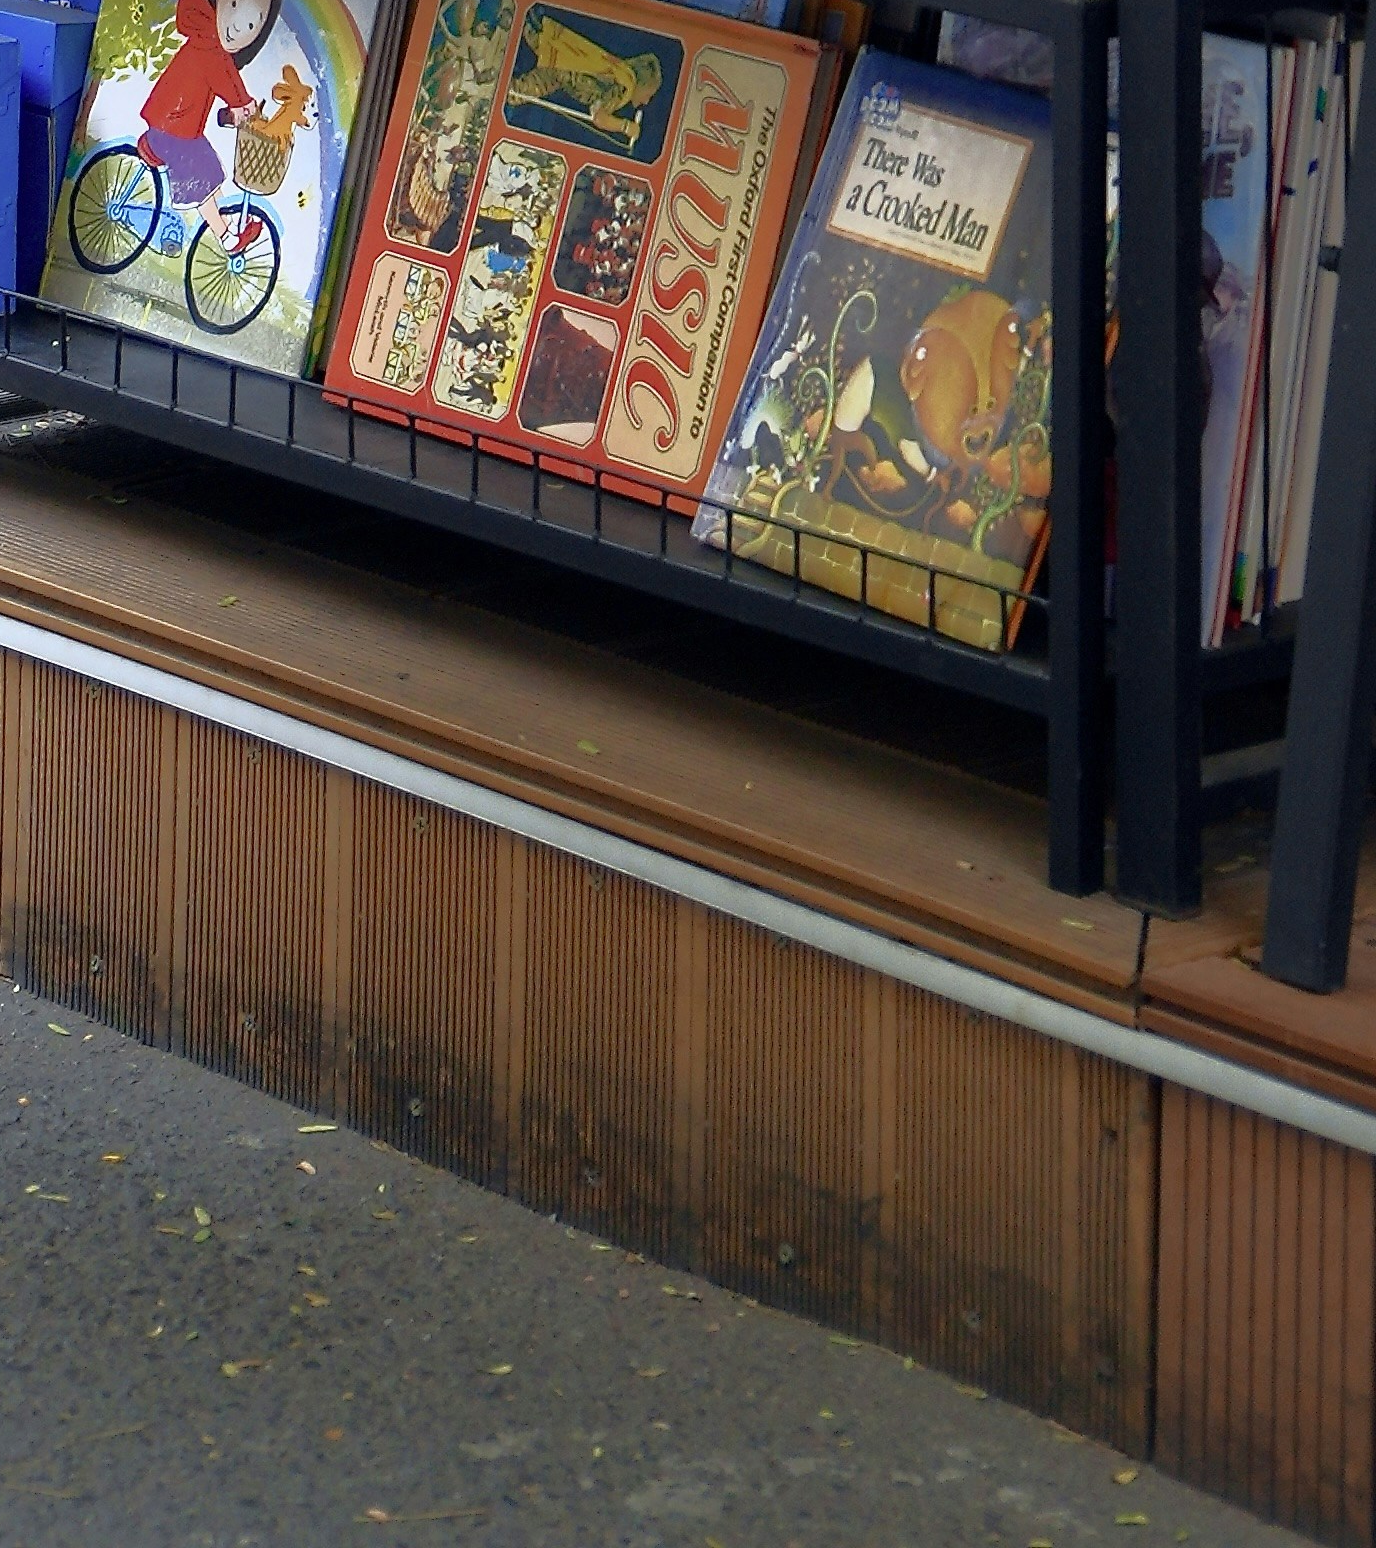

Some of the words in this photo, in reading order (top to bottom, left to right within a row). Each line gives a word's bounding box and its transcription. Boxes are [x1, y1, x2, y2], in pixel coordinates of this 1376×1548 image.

[758, 104, 779, 147] The
[739, 153, 769, 230] Oxford
[862, 136, 910, 177] There
[912, 151, 945, 189] Was
[846, 183, 863, 212] a
[863, 179, 948, 236] Crooked
[939, 202, 990, 252] Man
[621, 63, 755, 453] MUSIC
[730, 230, 751, 274] First
[695, 273, 739, 412] Companion
[689, 413, 708, 441] to
